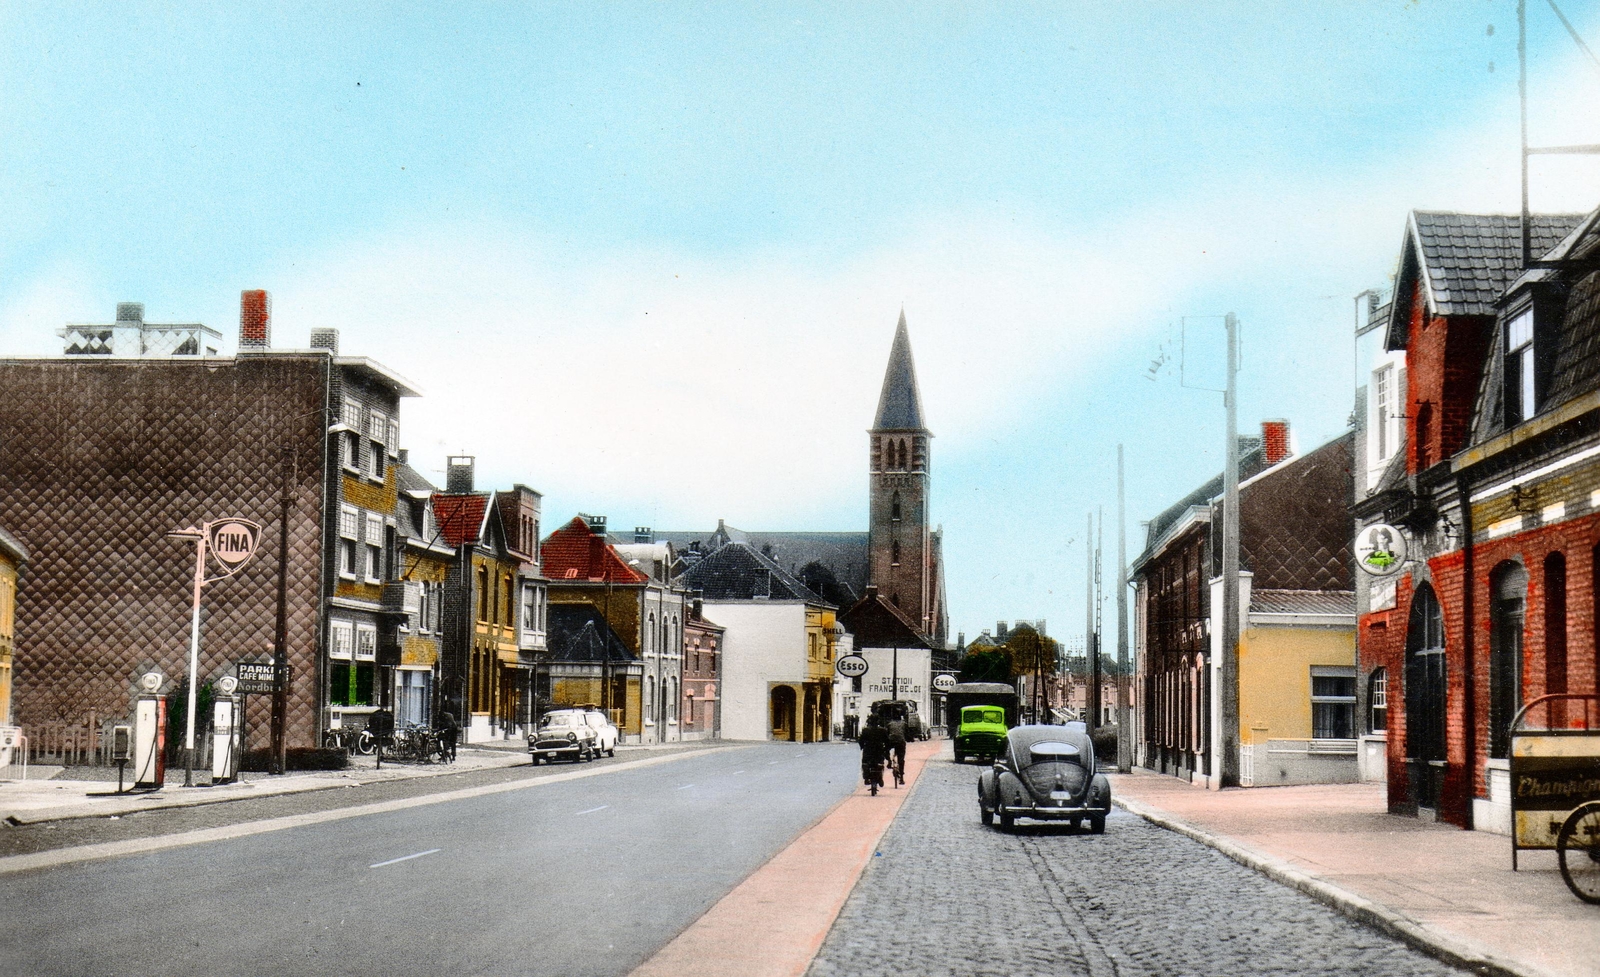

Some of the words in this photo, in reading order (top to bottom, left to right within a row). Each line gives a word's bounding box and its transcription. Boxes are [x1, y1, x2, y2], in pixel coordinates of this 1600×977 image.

[217, 533, 249, 552] FINA
[240, 664, 290, 675] PARKI
[239, 672, 257, 680] CAFE
[869, 684, 922, 693] FRANC-BEGE
